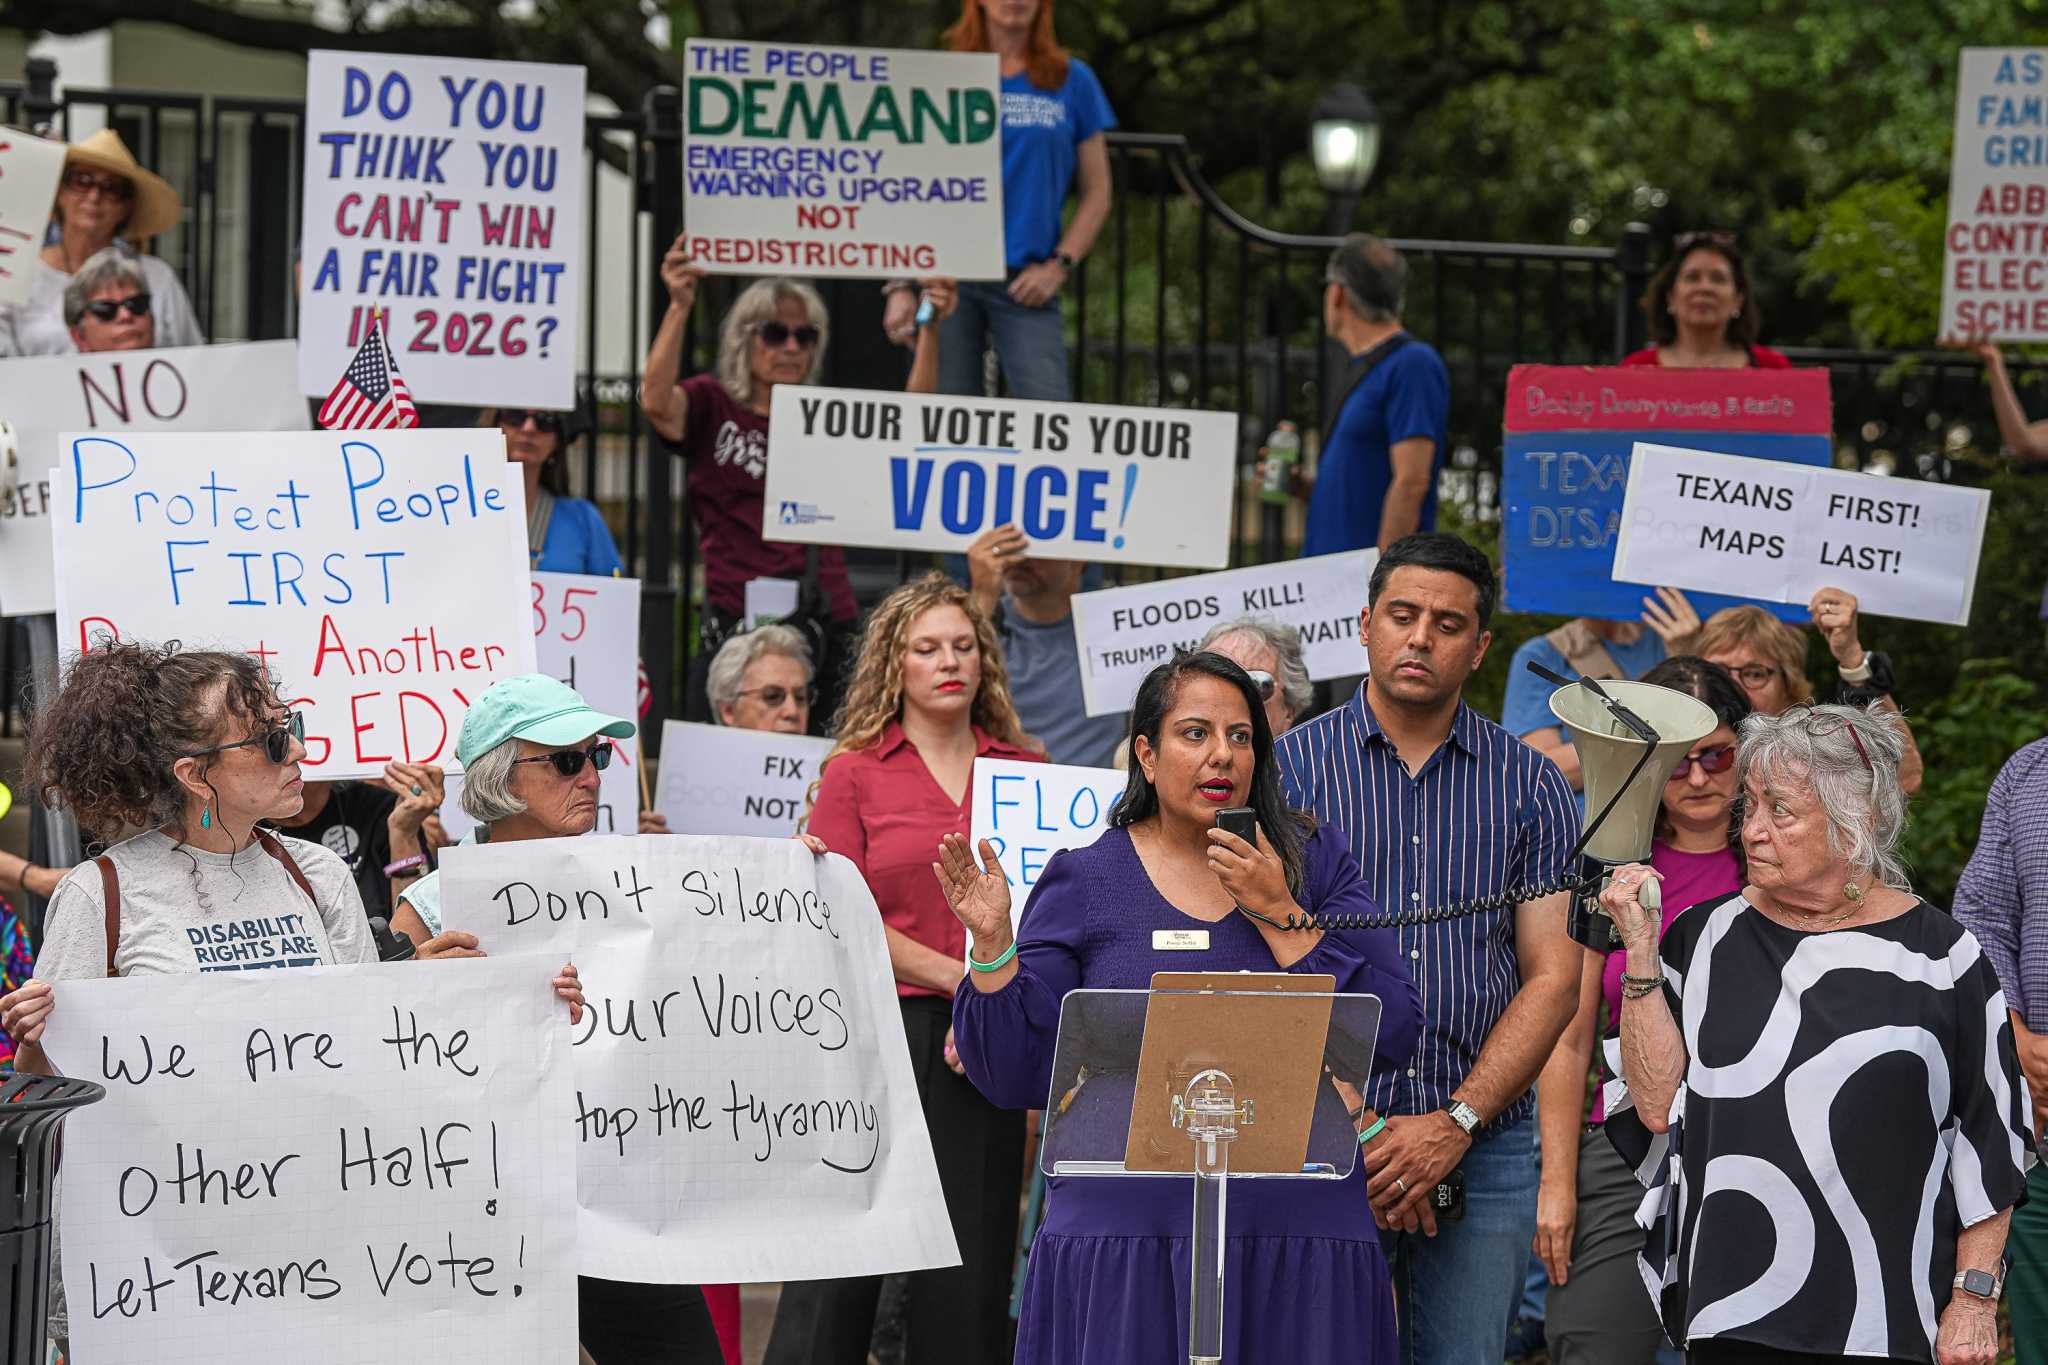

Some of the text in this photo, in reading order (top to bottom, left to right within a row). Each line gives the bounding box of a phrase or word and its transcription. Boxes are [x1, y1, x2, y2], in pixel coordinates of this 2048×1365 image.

[691, 46, 889, 81] THE PEOPLE
[1994, 53, 2043, 85] AS
[343, 66, 545, 133] DO YOU
[687, 76, 996, 145] DEMAND
[319, 132, 558, 192] THINK YOU
[687, 146, 883, 174] EMERGENCY
[687, 171, 986, 203] WARNING UPGRADE
[335, 190, 554, 249] CAN'T WIN
[797, 205, 860, 230] NOT
[312, 247, 566, 305] A FAIR FIGHT
[691, 237, 936, 269] REDISTRICTING
[408, 310, 559, 359] 2026?
[79, 358, 187, 428] NO
[800, 398, 1192, 460] YOUR VOTE IS YOUR
[72, 437, 505, 532] Protect People
[888, 455, 1139, 551] VOICE!
[1676, 473, 1794, 511] TEXANS
[1828, 494, 1921, 528] FIRST!
[166, 540, 405, 607] FIRST
[1699, 526, 1901, 574] MAPS LAST!
[1112, 582, 1304, 632] FLOODS KILL!
[313, 615, 505, 677] Another
[1101, 643, 1167, 668] TRUMP
[764, 755, 804, 780] FIX
[744, 795, 800, 821] NOT
[186, 914, 305, 945] DISABILITY
[493, 865, 839, 939] Don't Silence
[194, 937, 317, 963] RIGHTS ARE
[693, 974, 848, 1050] Voices
[102, 1006, 479, 1086] We Are the
[648, 1083, 712, 1136] the
[722, 1080, 880, 1173] tyranny
[118, 1120, 500, 1217] Other Half!
[1438, 1184, 1448, 1208] 5:04
[89, 1231, 525, 1320] Let Texans Vote!
